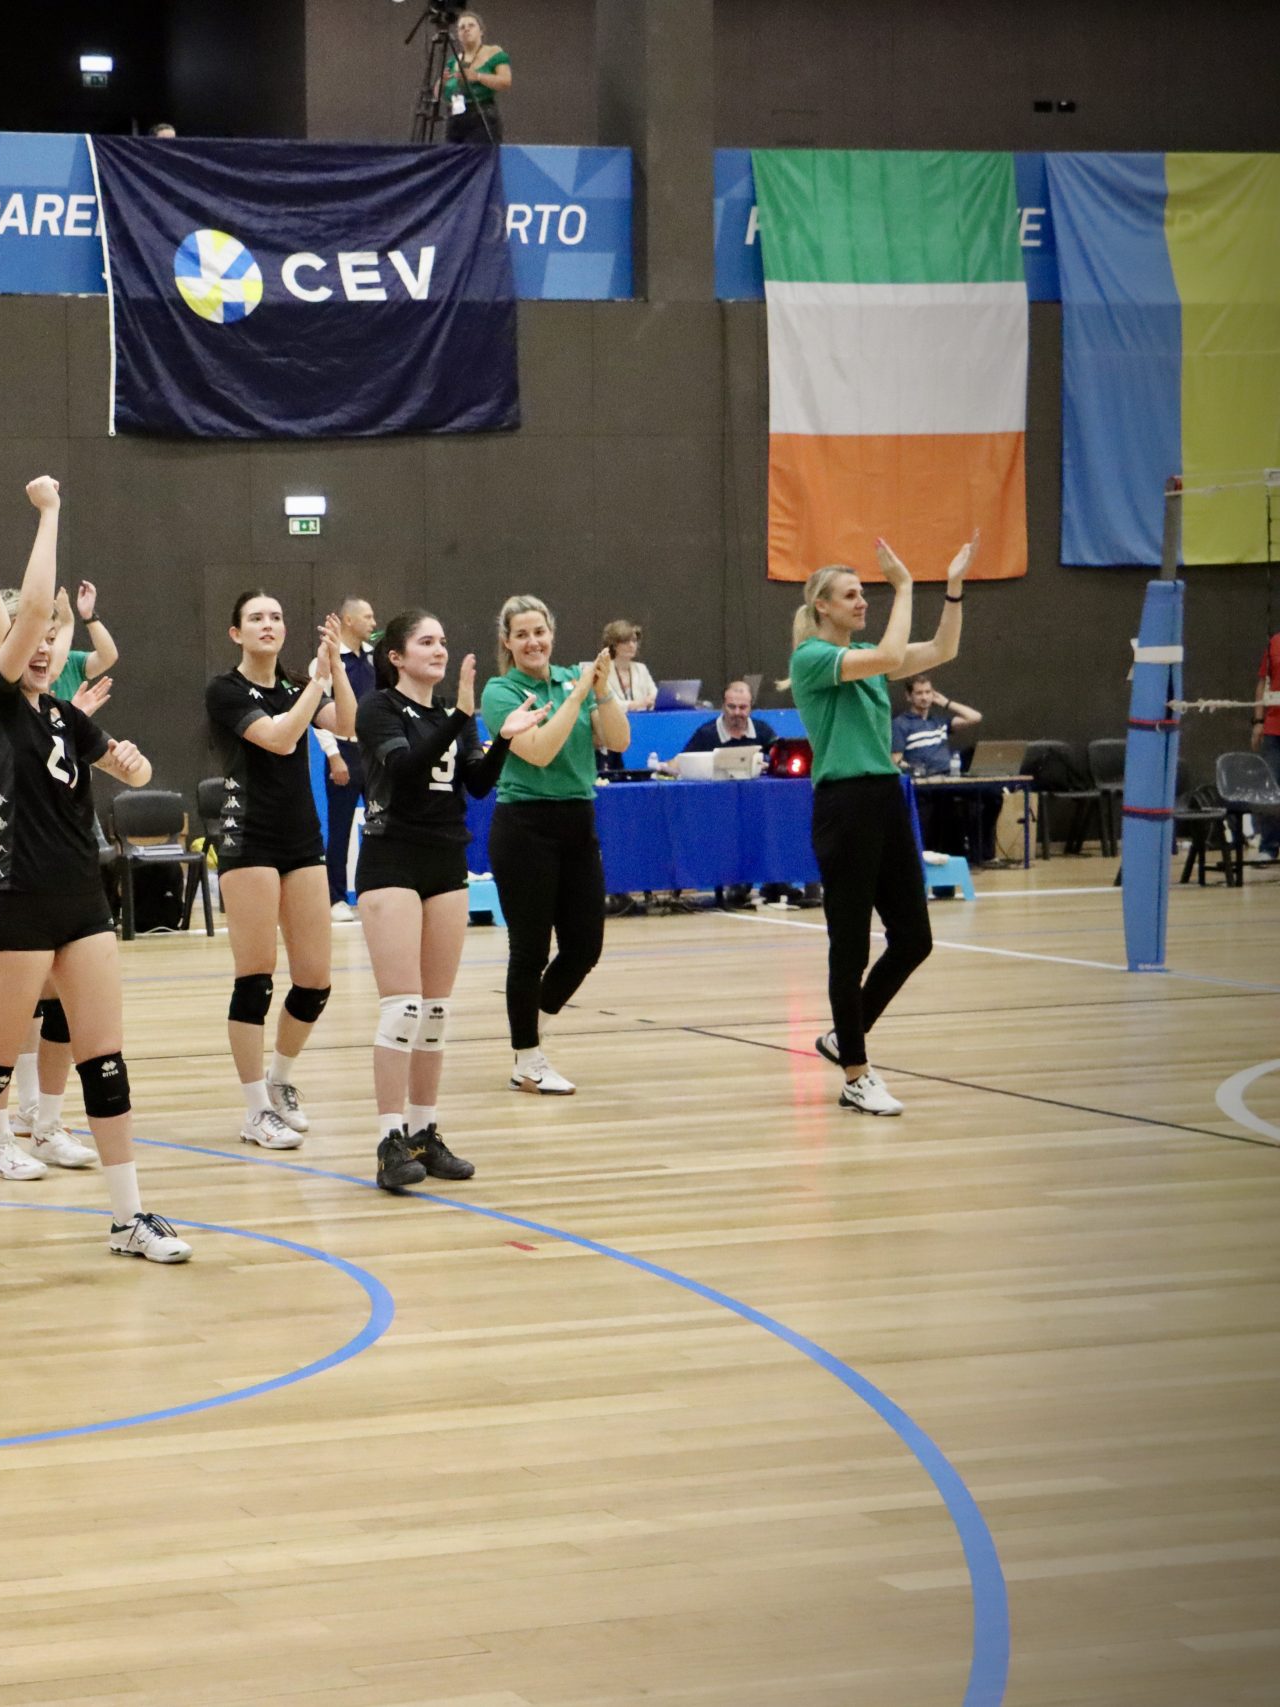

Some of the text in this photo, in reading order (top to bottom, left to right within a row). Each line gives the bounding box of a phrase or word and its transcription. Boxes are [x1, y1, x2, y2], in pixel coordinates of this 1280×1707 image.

[505, 203, 587, 246] RTO
[281, 245, 436, 303] CEV
[430, 738, 458, 783] 3
